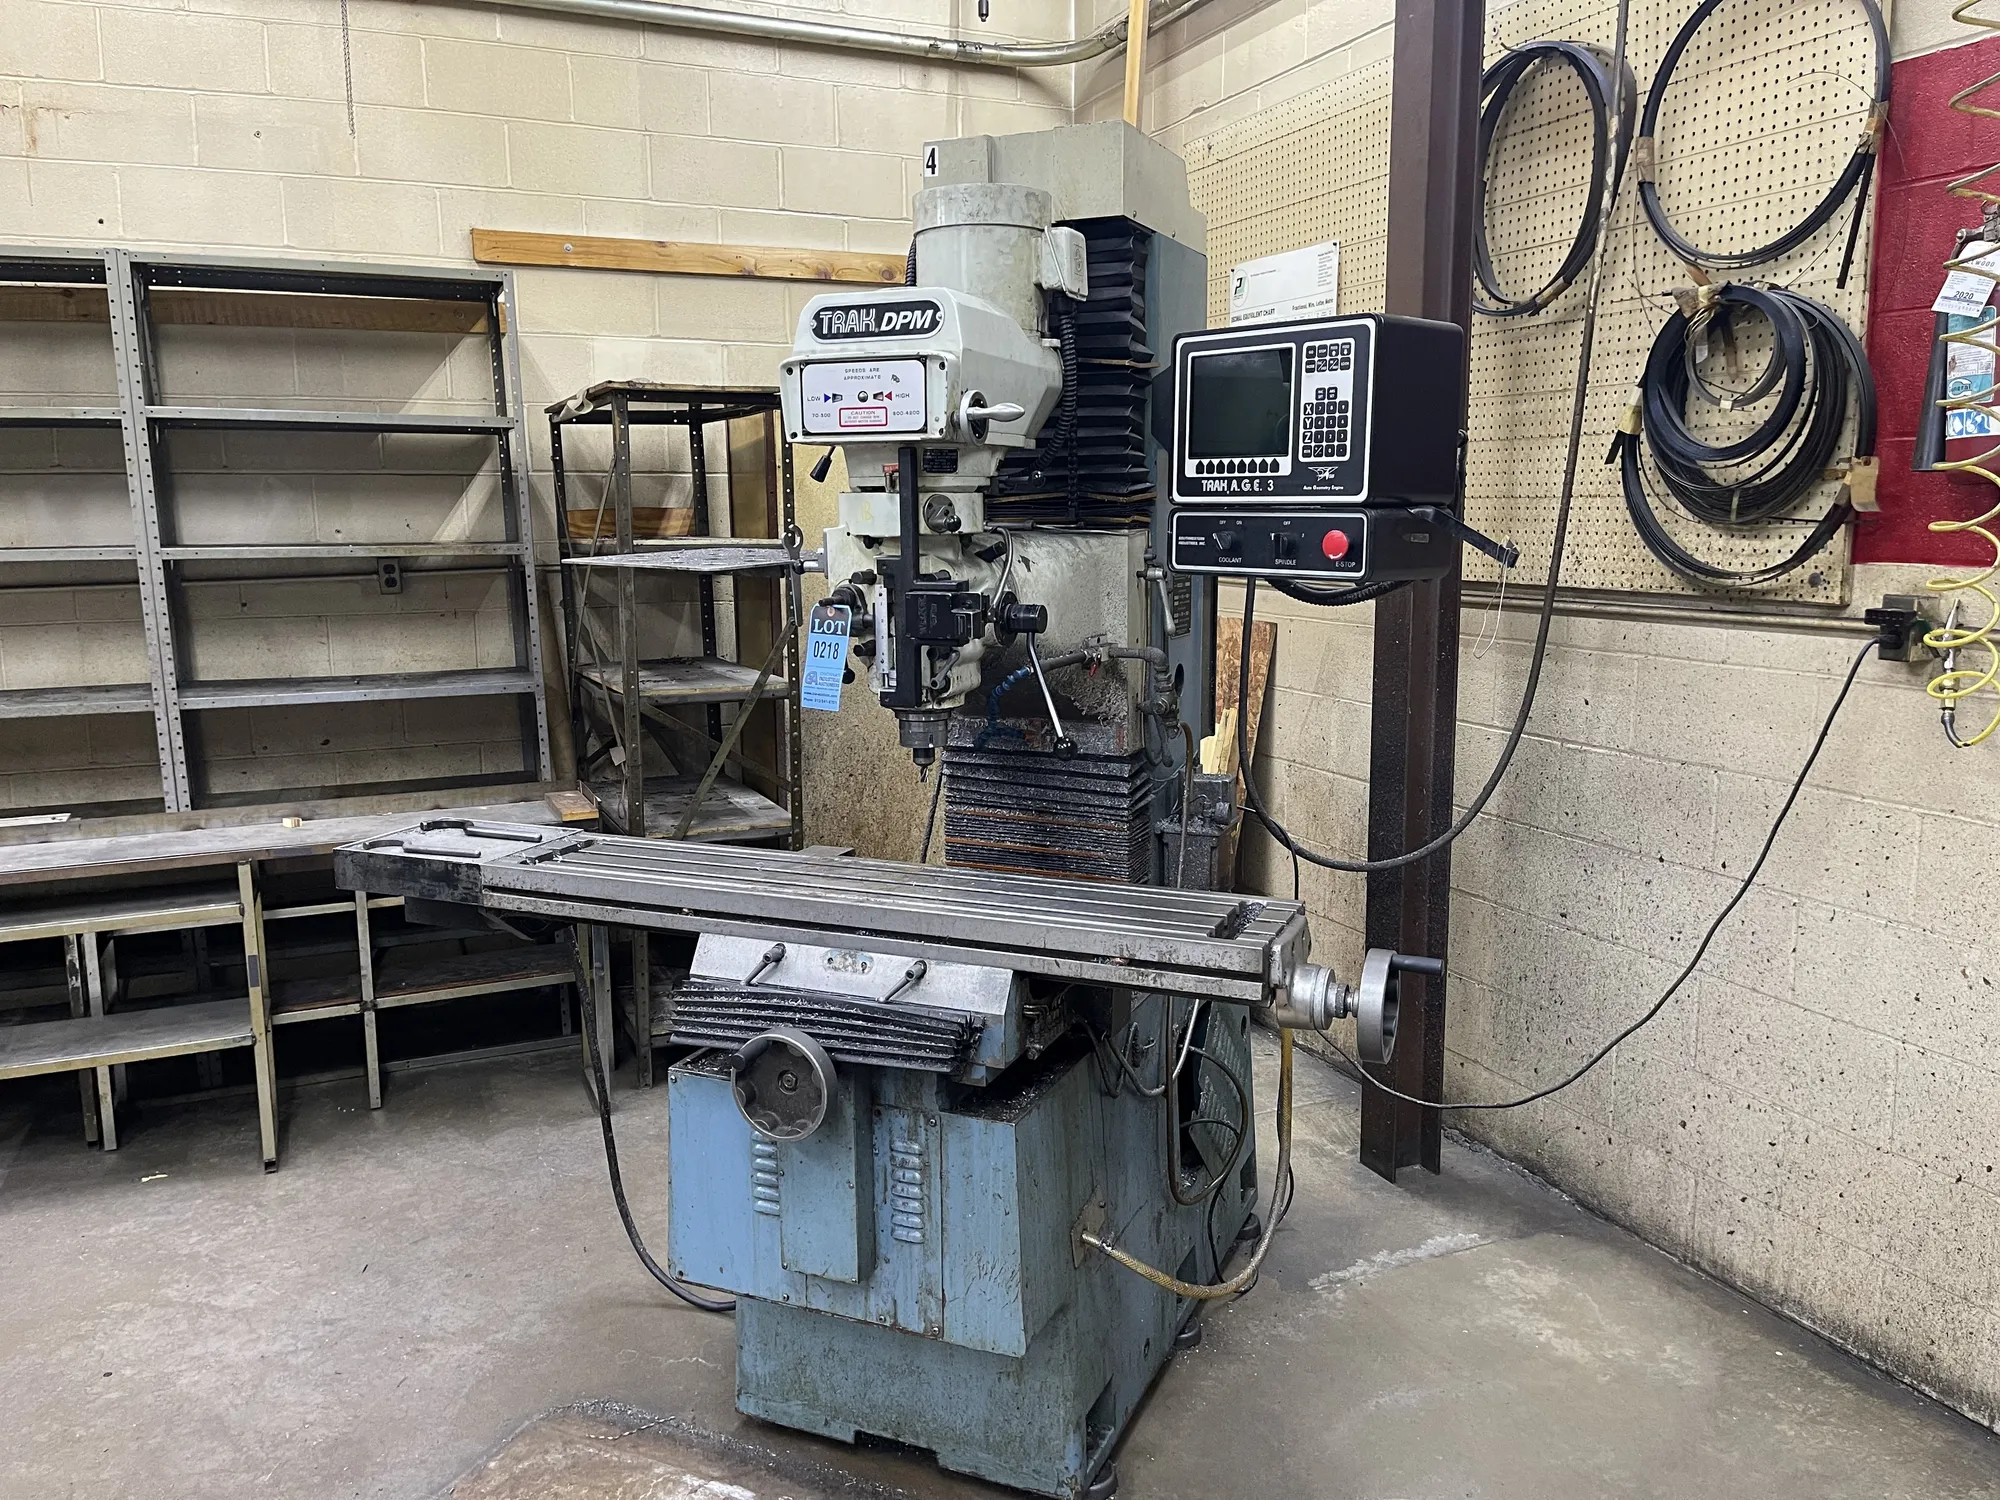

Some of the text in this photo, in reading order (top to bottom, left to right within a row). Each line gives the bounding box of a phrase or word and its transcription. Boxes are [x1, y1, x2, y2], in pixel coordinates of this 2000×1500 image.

[926, 147, 936, 175] 4
[1954, 291, 1974, 300] 2020
[820, 308, 934, 334] TRAK DPM
[1305, 403, 1312, 415] X
[1305, 418, 1312, 428] Y
[1304, 432, 1311, 443] Z
[1267, 480, 1274, 491] 3
[813, 619, 845, 634] LOT
[813, 640, 840, 660] 0218
